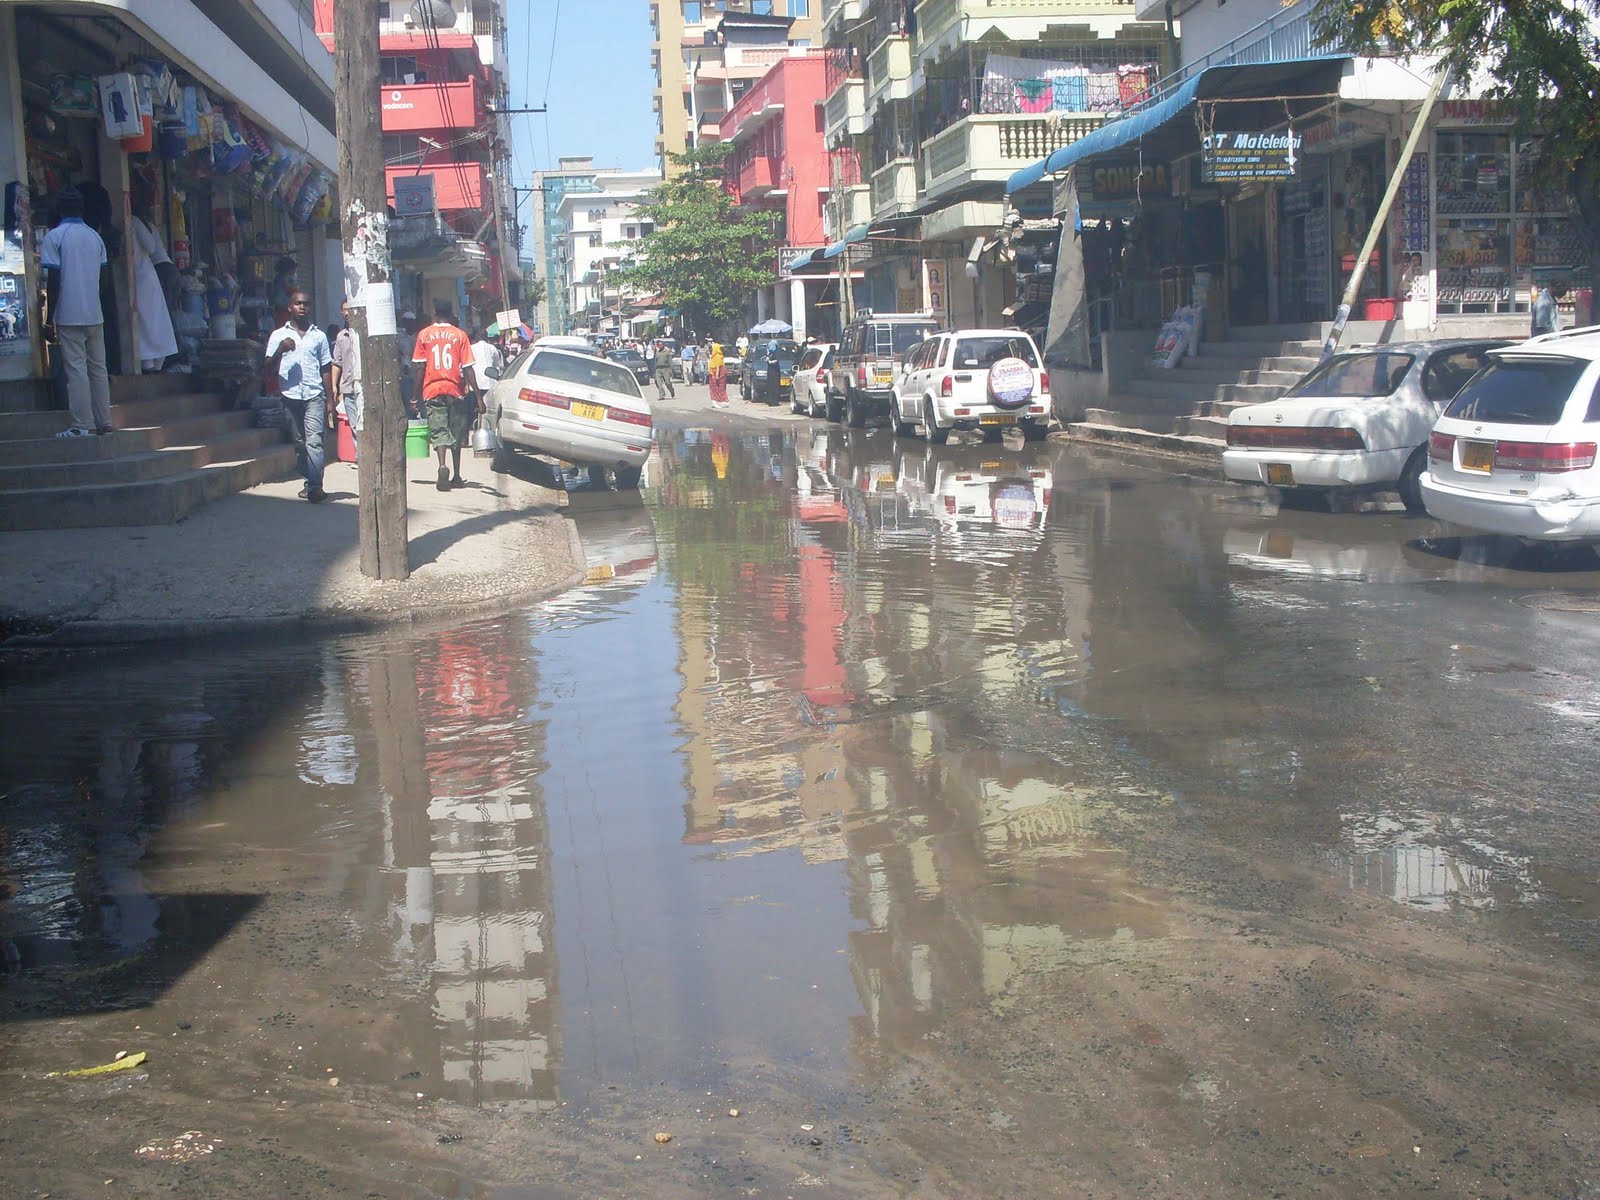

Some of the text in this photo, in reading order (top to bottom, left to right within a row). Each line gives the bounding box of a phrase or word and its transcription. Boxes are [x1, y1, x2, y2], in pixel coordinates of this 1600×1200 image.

[1233, 134, 1302, 149] Matelefoni
[425, 331, 459, 344] CARRICK
[431, 343, 453, 370] 16
[582, 409, 596, 419] ATR
